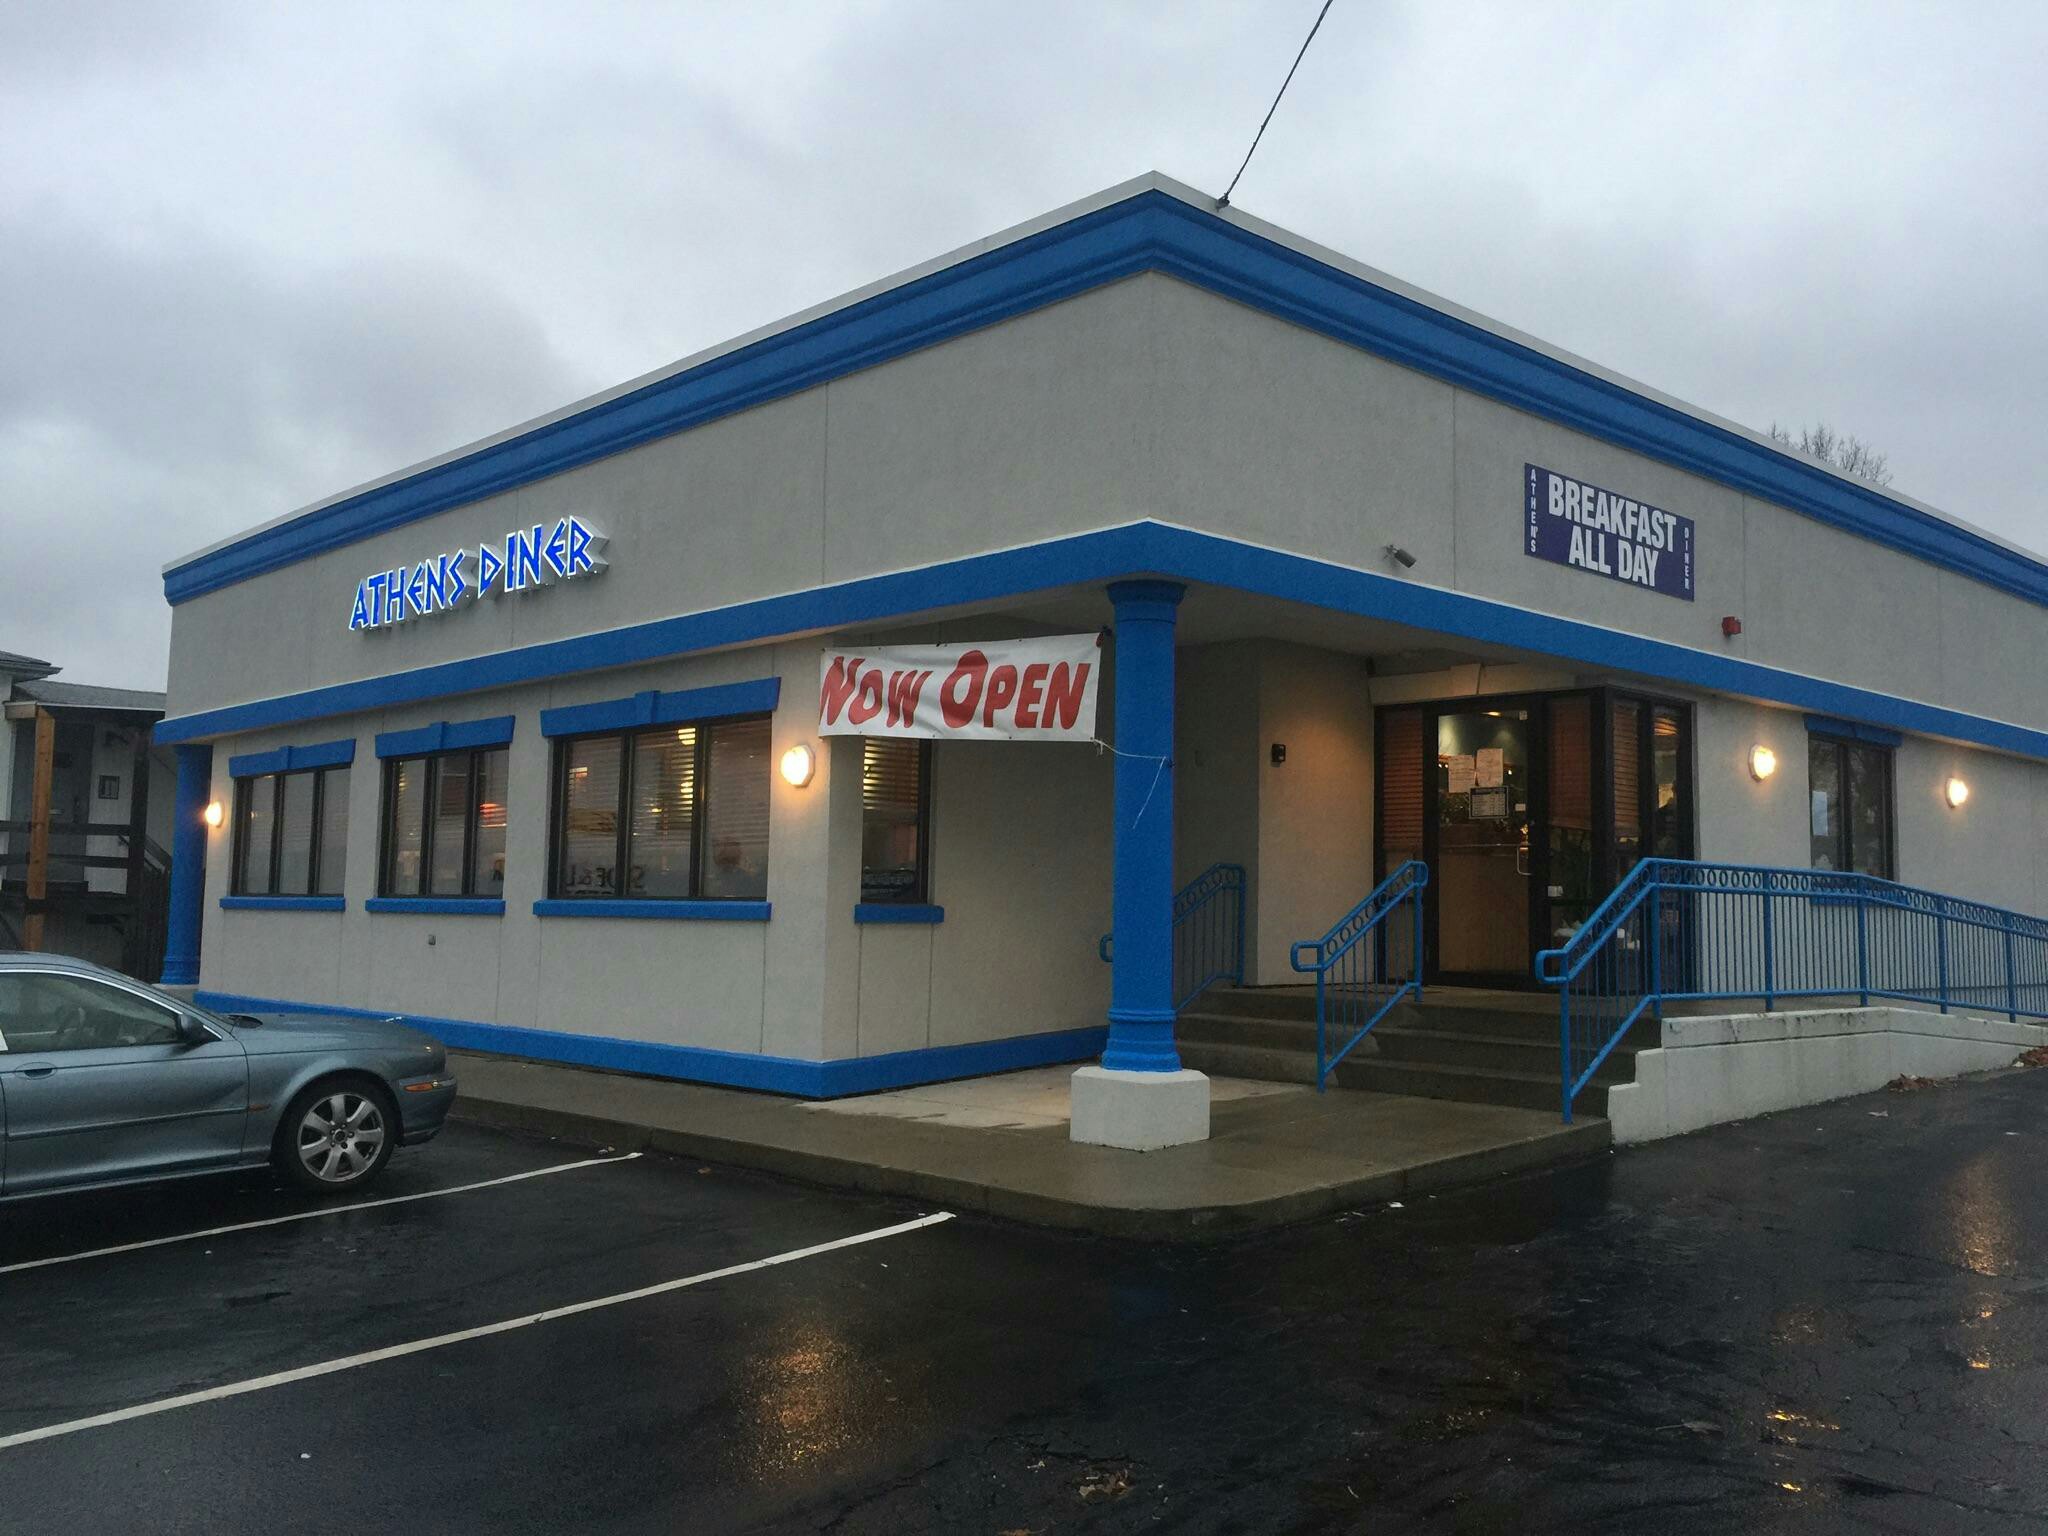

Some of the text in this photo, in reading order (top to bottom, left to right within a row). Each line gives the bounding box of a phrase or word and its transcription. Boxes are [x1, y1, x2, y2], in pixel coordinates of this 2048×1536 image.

[1530, 468, 1538, 552] ATHENS
[1549, 473, 1676, 552] BREAKFAST
[349, 515, 594, 630] ATHENS DINER
[1568, 525, 1659, 587] ALL DAY
[819, 650, 1091, 730] NOW OPEN
